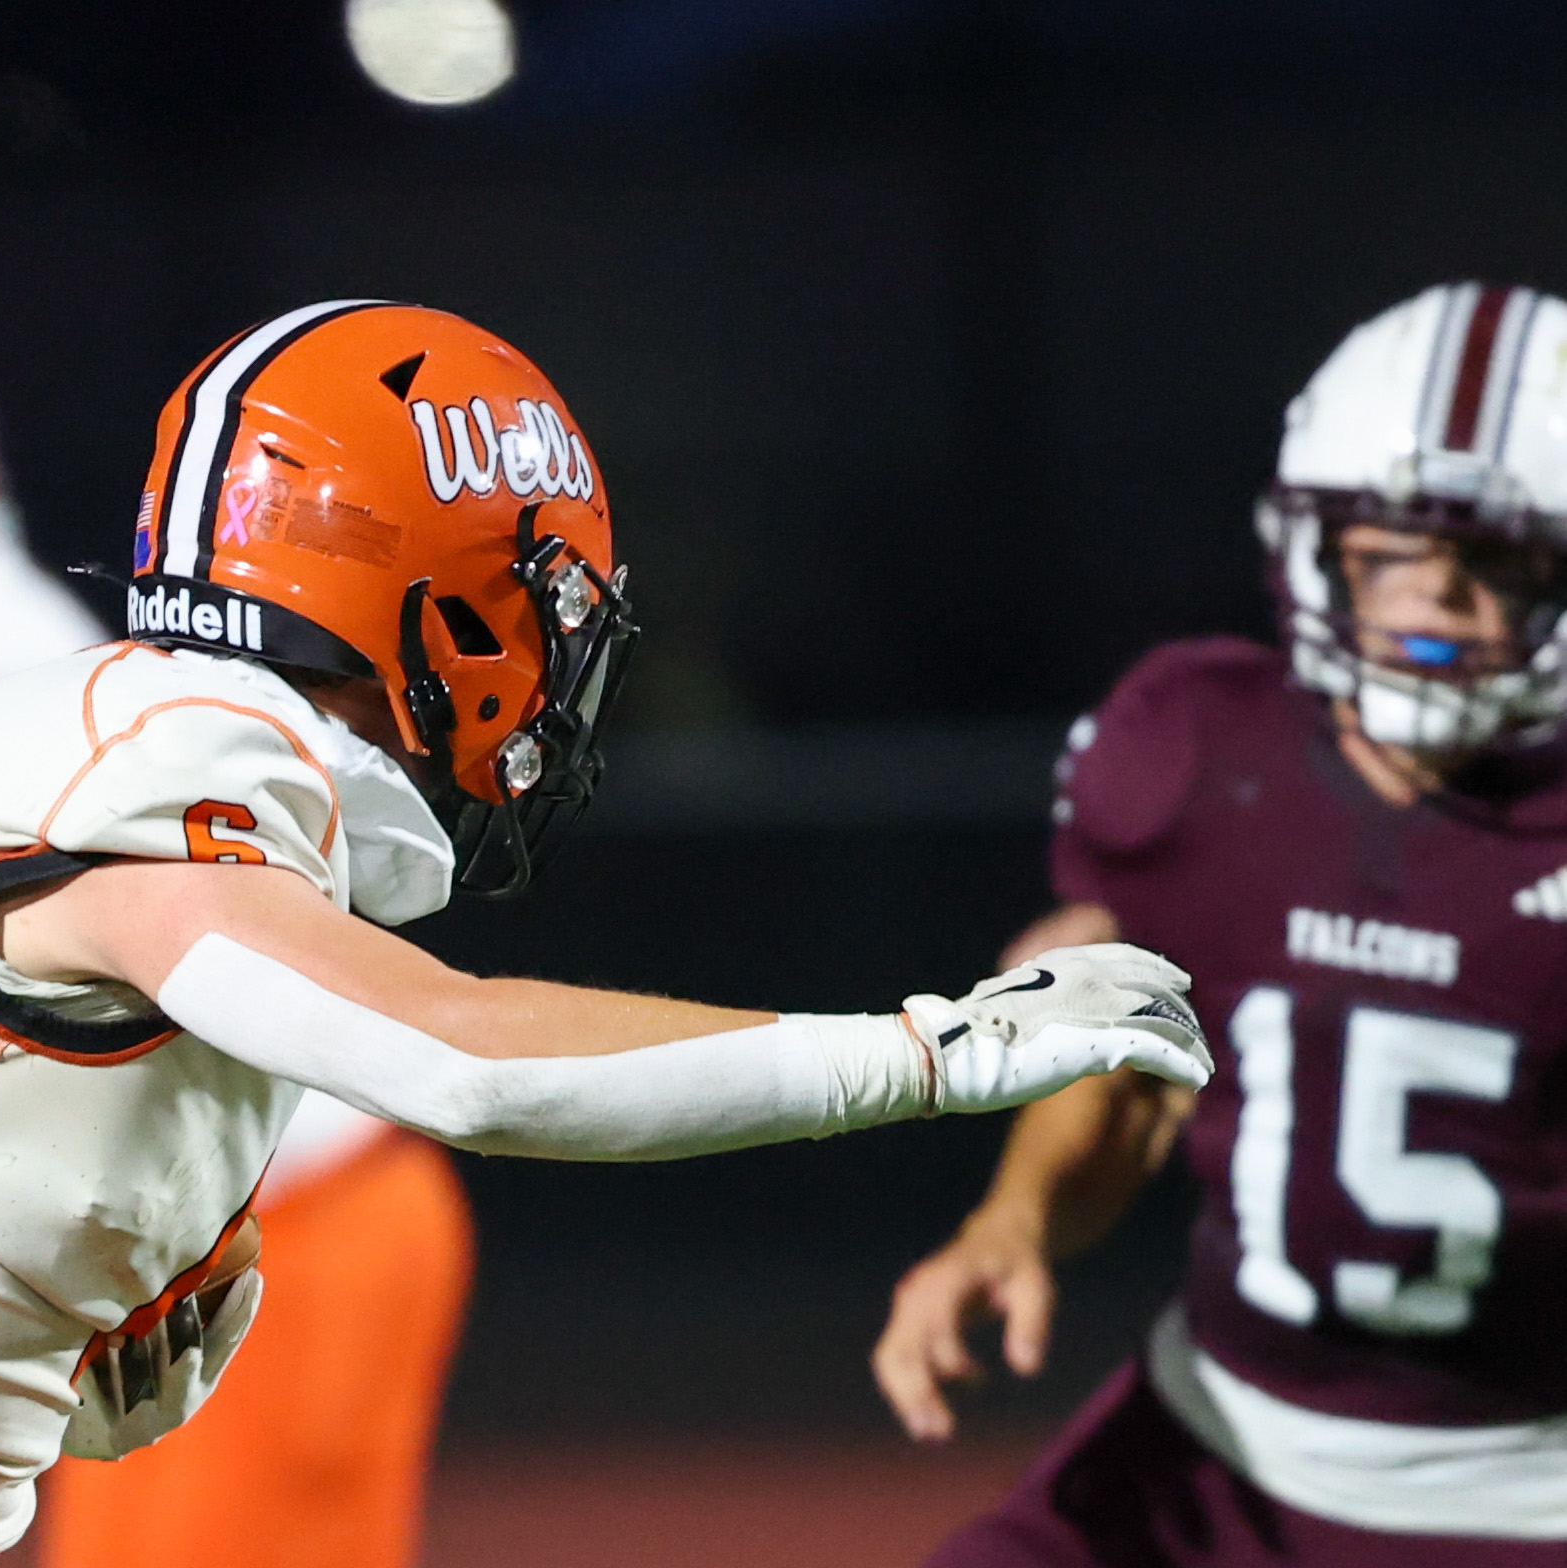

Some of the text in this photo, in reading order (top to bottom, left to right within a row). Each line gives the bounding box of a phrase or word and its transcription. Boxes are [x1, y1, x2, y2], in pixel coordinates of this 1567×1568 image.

[410, 397, 595, 504] Wells
[127, 583, 263, 652] Riddell
[183, 799, 267, 866] 6
[1287, 907, 1461, 984] FALCONS
[1230, 987, 1519, 1334] 15
